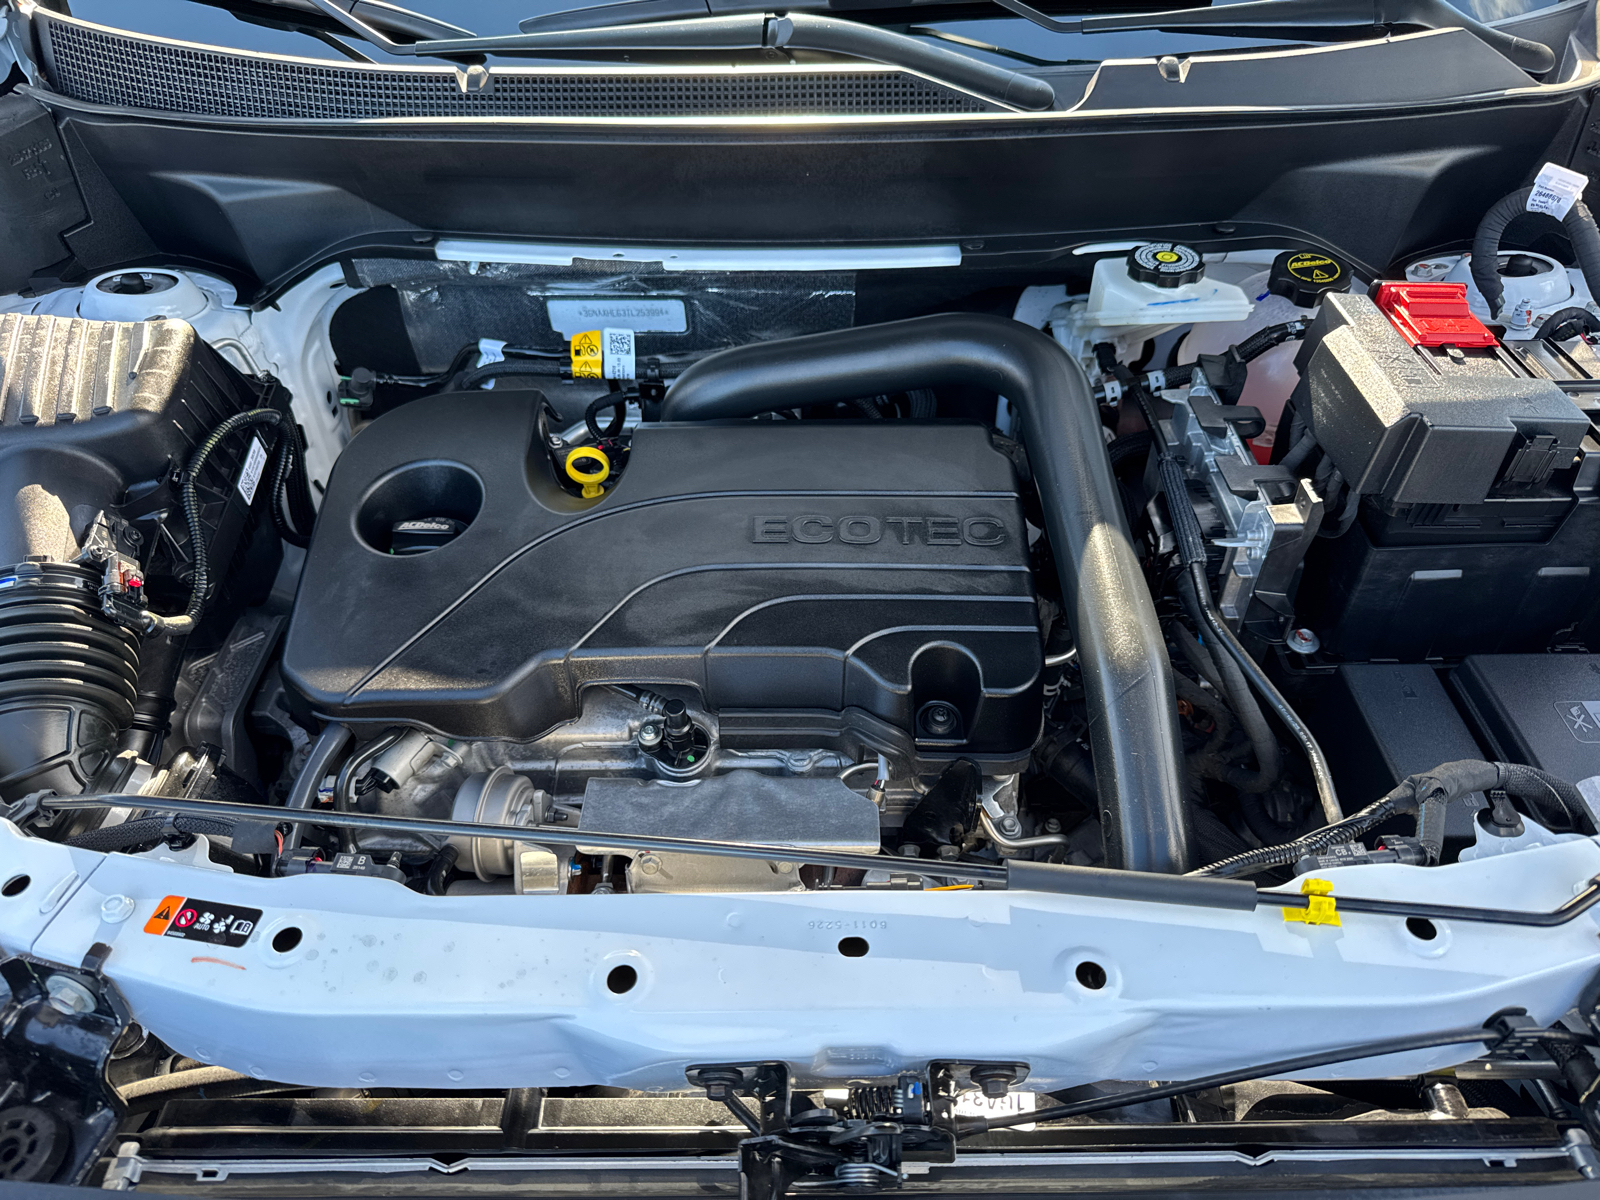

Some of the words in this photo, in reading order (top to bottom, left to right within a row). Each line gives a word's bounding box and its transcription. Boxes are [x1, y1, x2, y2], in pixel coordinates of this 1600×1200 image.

[1290, 259, 1331, 269] ACDelco
[398, 521, 449, 531] ACDelco
[752, 515, 1006, 546] ECOTEC
[357, 855, 366, 865] B
[193, 923, 210, 931] AUTO
